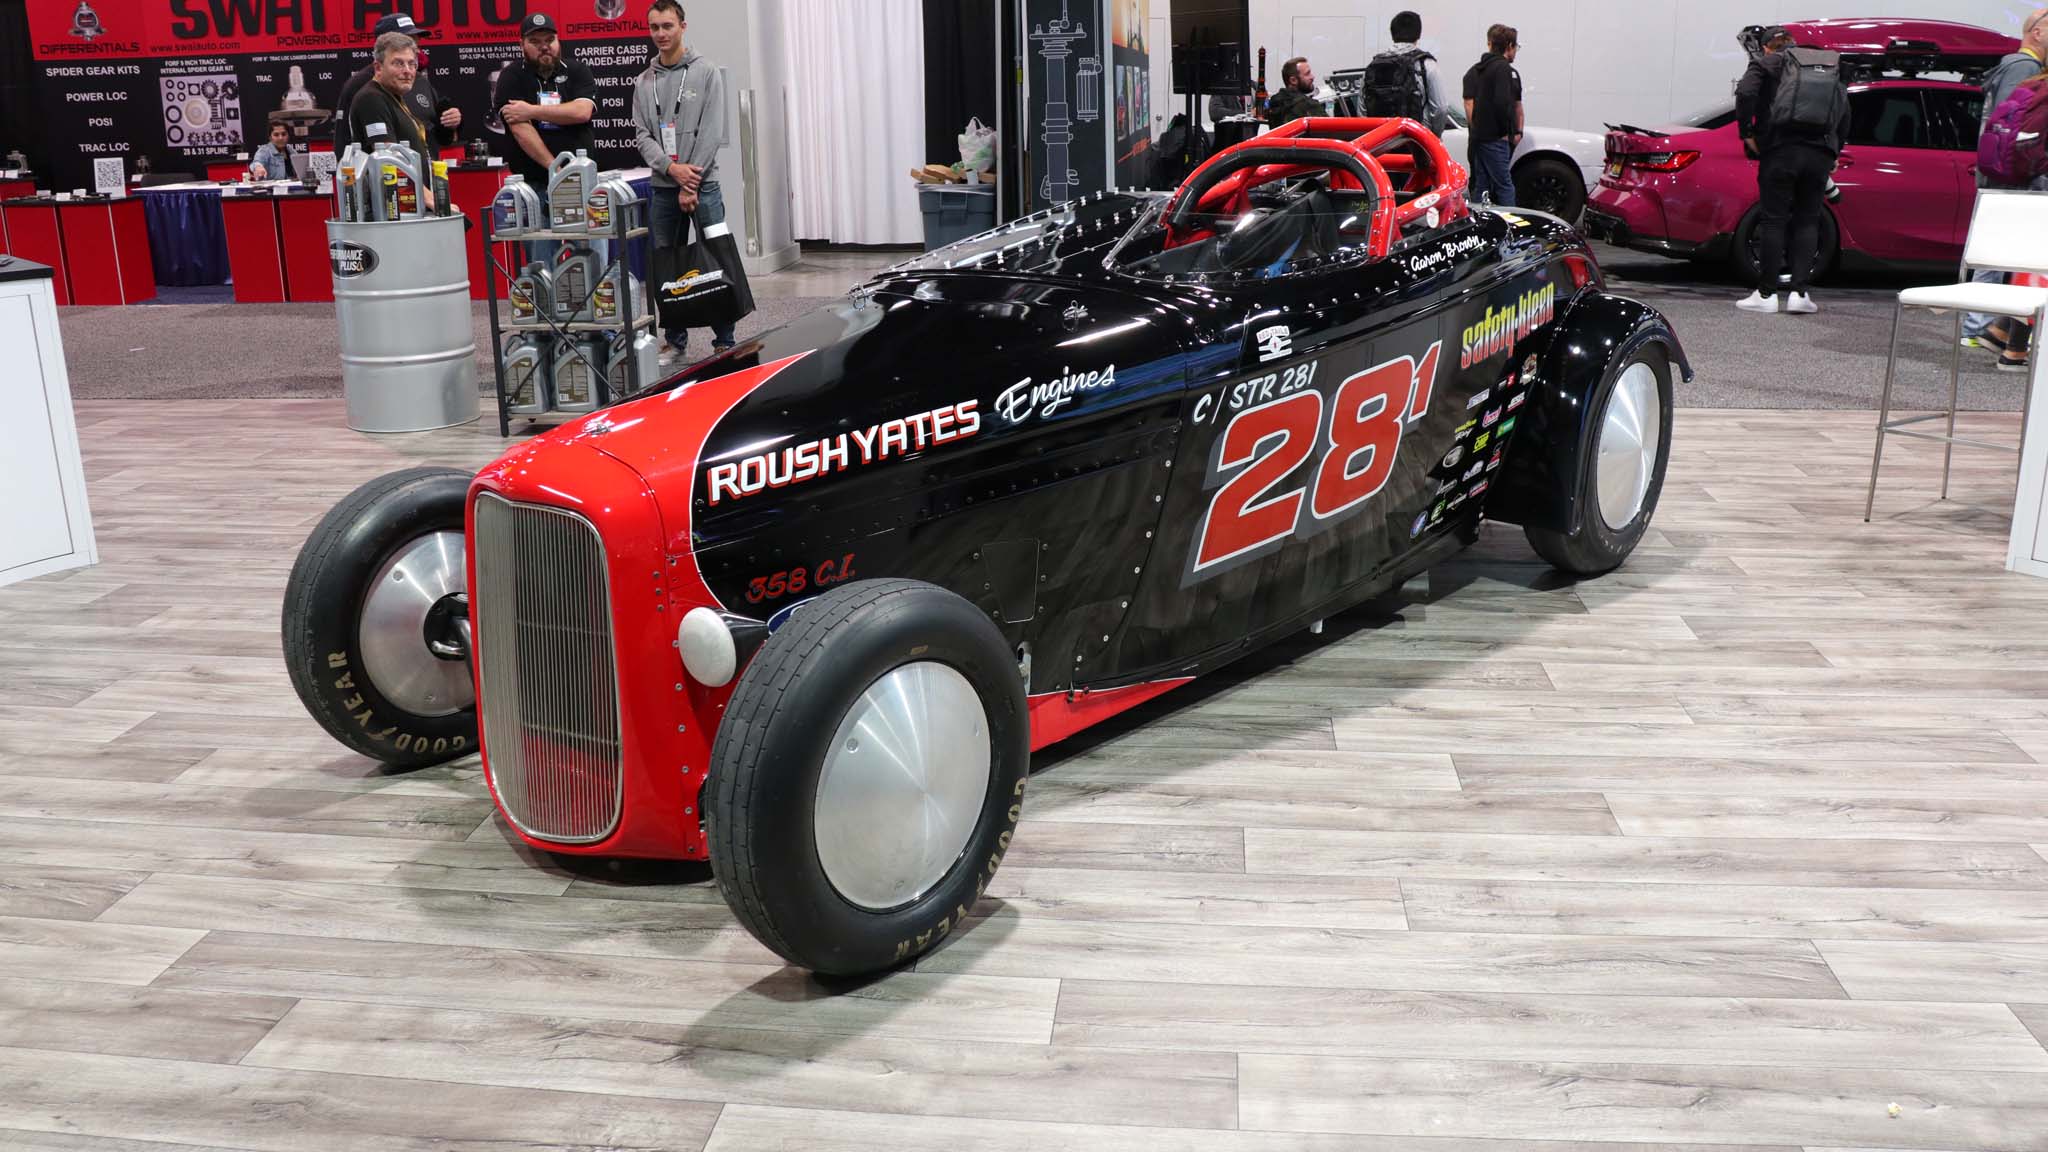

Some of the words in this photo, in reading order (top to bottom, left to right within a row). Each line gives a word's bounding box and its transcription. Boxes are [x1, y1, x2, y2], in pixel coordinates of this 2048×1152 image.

[277, 34, 341, 46] POWERING
[39, 42, 140, 55] DIFFERENTIALS
[574, 47, 615, 57] CARRIER
[616, 44, 648, 55] CASES
[576, 56, 648, 66] OADED-EMPTY
[46, 67, 83, 77] SPIDER
[86, 66, 115, 75] GEAR
[117, 65, 140, 74] KITS
[436, 68, 450, 76] LOC
[460, 66, 476, 75] POSI
[256, 75, 272, 83] TRAC
[318, 72, 332, 80] LOC
[66, 92, 103, 102] POWER
[105, 91, 128, 101] LOC
[602, 98, 624, 107] POSI
[88, 117, 113, 127] POSI
[592, 119, 610, 128] TRU
[79, 143, 107, 152] TRAC
[109, 142, 130, 151] LOC
[286, 143, 308, 151] PLINE
[594, 140, 617, 149] TRAC
[620, 138, 638, 148] LOC
[206, 146, 229, 155] SPLINE
[1442, 235, 1487, 258] Brown
[340, 260, 356, 271] PLUS
[1280, 360, 1318, 396] 281
[708, 433, 848, 507] ROUSH
[850, 399, 981, 465] YATES
[994, 363, 1115, 425] Engines
[745, 567, 807, 604] 358
[815, 553, 857, 586] C.I.
[327, 651, 466, 753] GOODYEAR
[895, 777, 1026, 961] GOODYEAR
